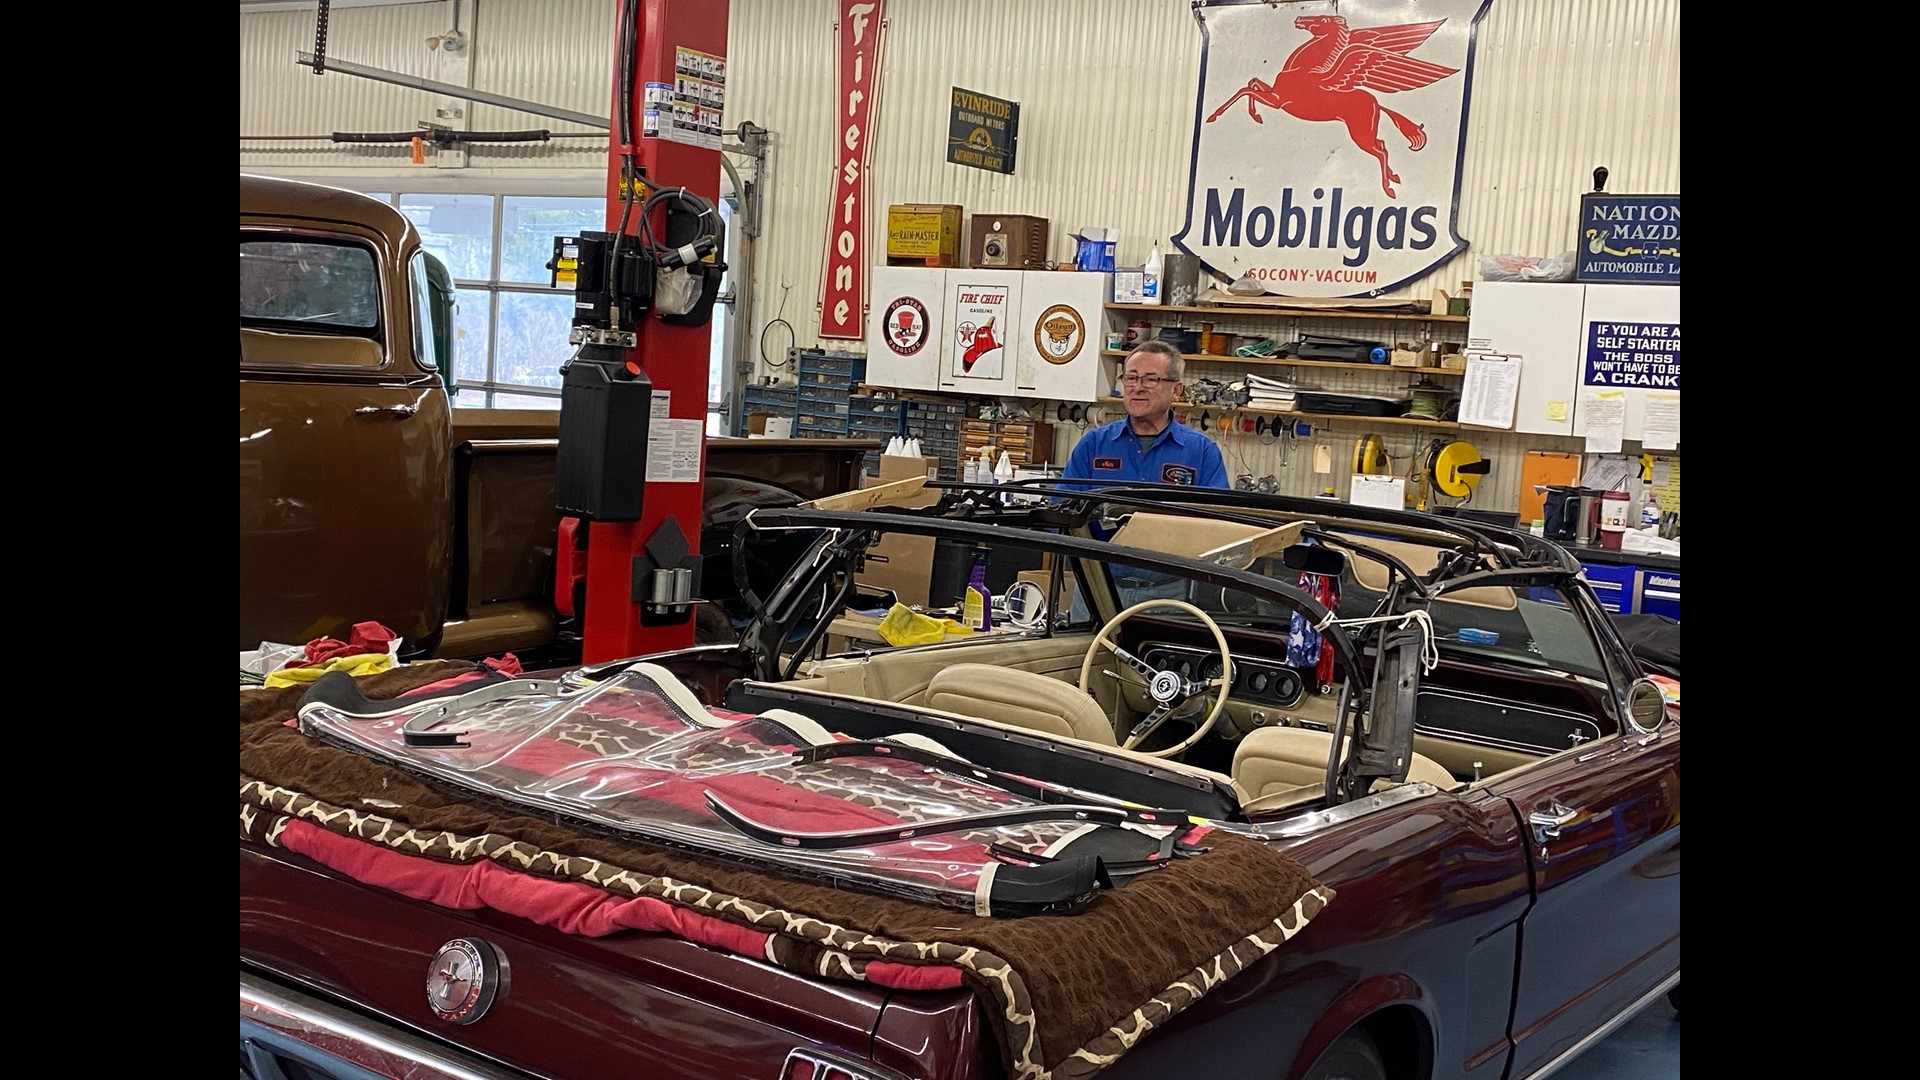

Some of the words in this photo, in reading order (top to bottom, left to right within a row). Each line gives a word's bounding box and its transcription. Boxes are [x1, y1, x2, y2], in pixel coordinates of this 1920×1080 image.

[953, 91, 1011, 119] EVINRUDE
[833, 2, 875, 327] Firestone
[1202, 188, 1438, 267] Mobilgas
[1611, 224, 1680, 240] MAZD
[900, 230, 939, 241] RAIN-MASTER
[1584, 262, 1664, 274] AUTOMOBILE
[1248, 268, 1377, 284] SOCONY-VACUUM
[960, 294, 979, 303] FIRE
[980, 294, 1004, 304] CHIEF
[1598, 325, 1609, 334] IF
[1612, 325, 1638, 336] YOU
[1641, 326, 1669, 337] ARE
[1597, 337, 1625, 348] SELF
[1627, 338, 1680, 351] STARTER
[1603, 352, 1630, 361] THE
[1634, 353, 1673, 363] BOSS
[1593, 361, 1622, 371] WON'T
[1624, 363, 1649, 373] HAVE
[1651, 364, 1665, 373] TO
[1668, 365, 1680, 374] BE
[1592, 372, 1607, 382] A
[1611, 373, 1678, 386] CRANK
